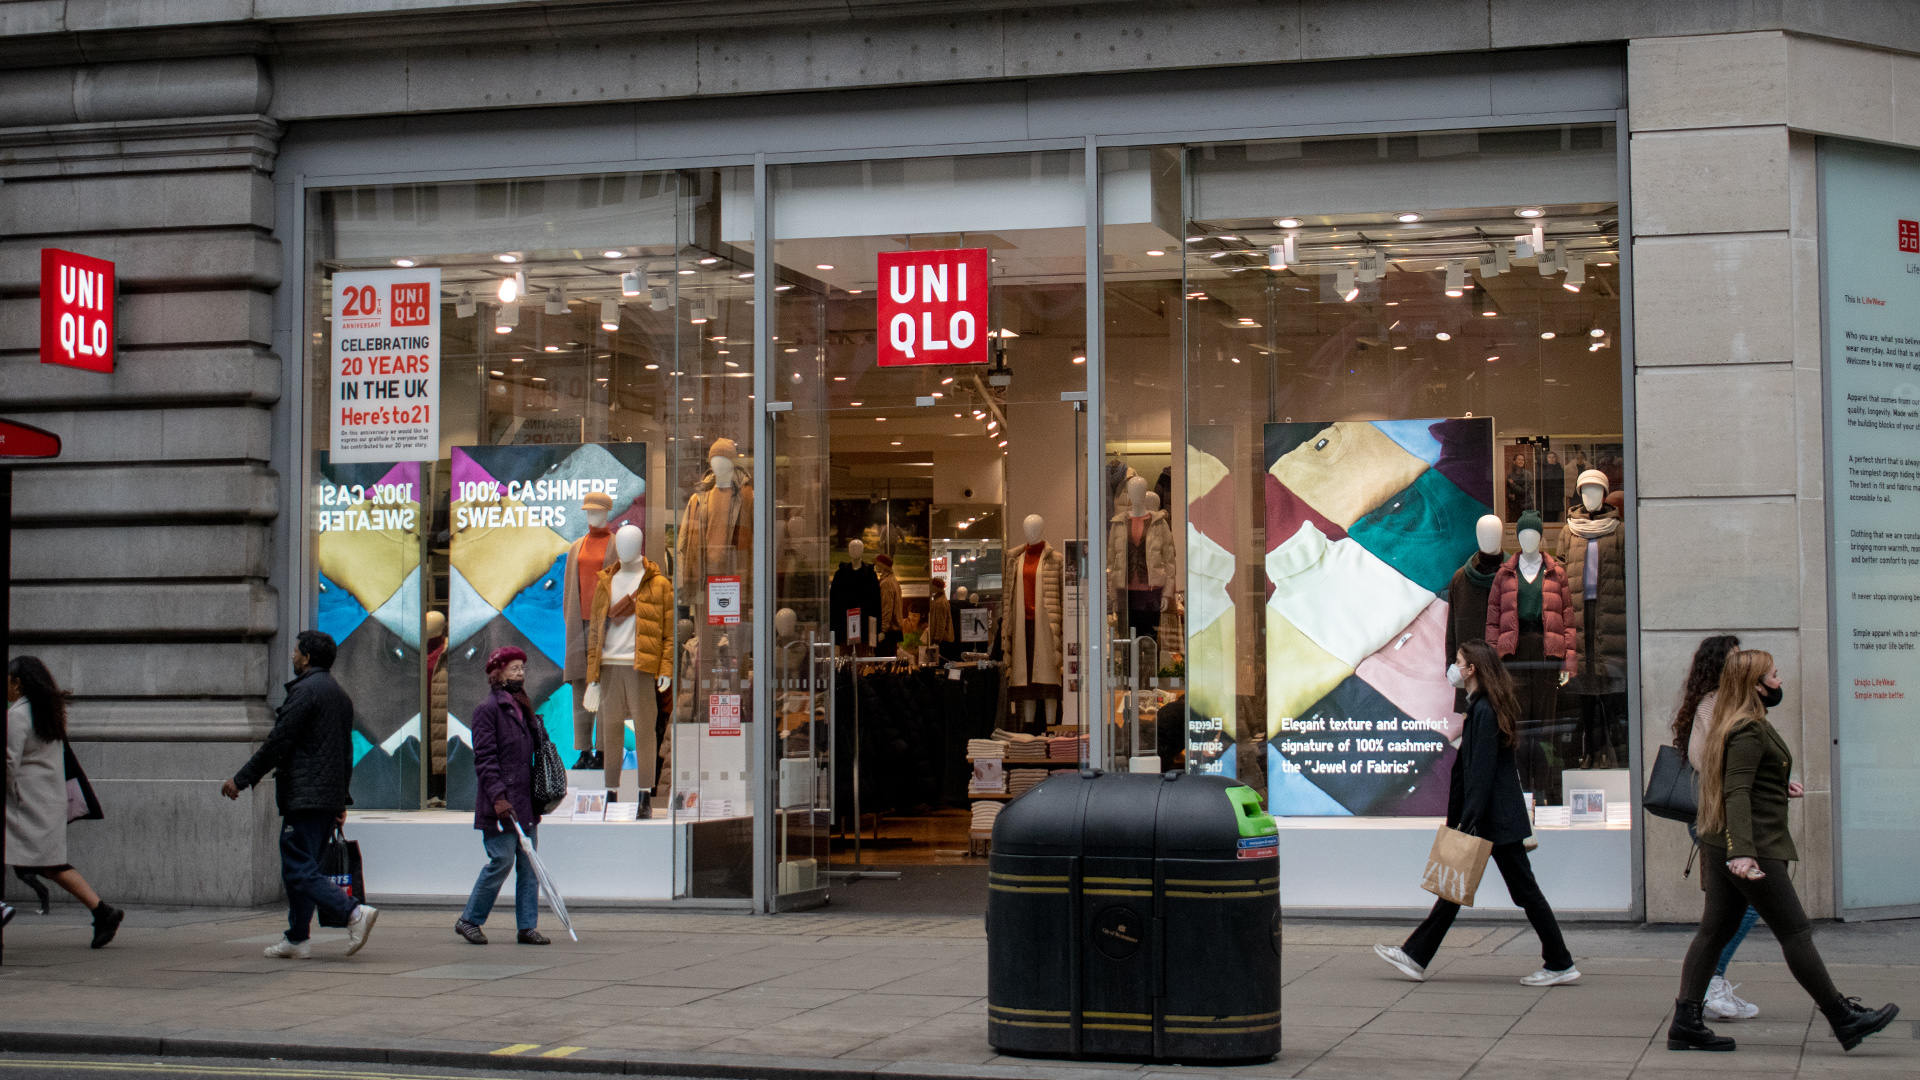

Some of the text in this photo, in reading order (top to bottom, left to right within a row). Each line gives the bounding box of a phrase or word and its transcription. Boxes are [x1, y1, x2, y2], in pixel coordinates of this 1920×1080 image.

[60, 264, 104, 312] UNI
[890, 263, 966, 304] UNI
[342, 285, 376, 316] 20
[395, 289, 423, 303] UNI
[1845, 295, 1855, 303] This
[1862, 296, 1886, 306] LifeWear
[395, 306, 425, 324] QLO
[60, 314, 108, 358] QLO
[890, 310, 976, 358] QLO
[1845, 331, 1857, 339] Who
[341, 336, 429, 352] CELEBRATING
[342, 354, 429, 376] 20 YEARS
[1846, 357, 1870, 365] Welcome
[1895, 362, 1904, 370] way
[342, 379, 428, 400] IN THE UK
[1847, 393, 1868, 402] Apparel
[1869, 394, 1880, 402] that
[1898, 397, 1910, 405] from
[342, 405, 429, 426] Here's to 21
[1893, 409, 1906, 417] Made
[1848, 418, 1856, 426] the
[1858, 419, 1878, 429] building
[1849, 455, 1853, 463] A
[1854, 456, 1874, 464] perfect
[1875, 456, 1887, 464] shirt
[1888, 457, 1898, 465] that
[1860, 468, 1881, 477] simplest
[1882, 470, 1898, 479] design
[1900, 471, 1914, 480] hiding
[1849, 480, 1859, 488] The
[459, 481, 501, 503] 100%
[456, 506, 566, 528] SWEATERS
[1850, 530, 1872, 539] Clothing
[1851, 543, 1872, 552] bringing
[1888, 544, 1909, 552] warmth,
[1873, 593, 1886, 602] stops
[1888, 594, 1912, 602] improving
[1853, 629, 1871, 638] Simple
[1872, 630, 1891, 638] apparel
[1854, 642, 1859, 650] to
[1860, 642, 1874, 650] make
[1889, 642, 1897, 650] life
[1854, 679, 1871, 688] Uniqlo
[1854, 692, 1872, 700] Simple
[1281, 717, 1448, 733] Elegant texture and comfort
[1281, 738, 1443, 752] signature of 100% cashmere
[1282, 760, 1301, 773] the
[1350, 759, 1363, 773] of
[1422, 861, 1468, 900] ZARA
